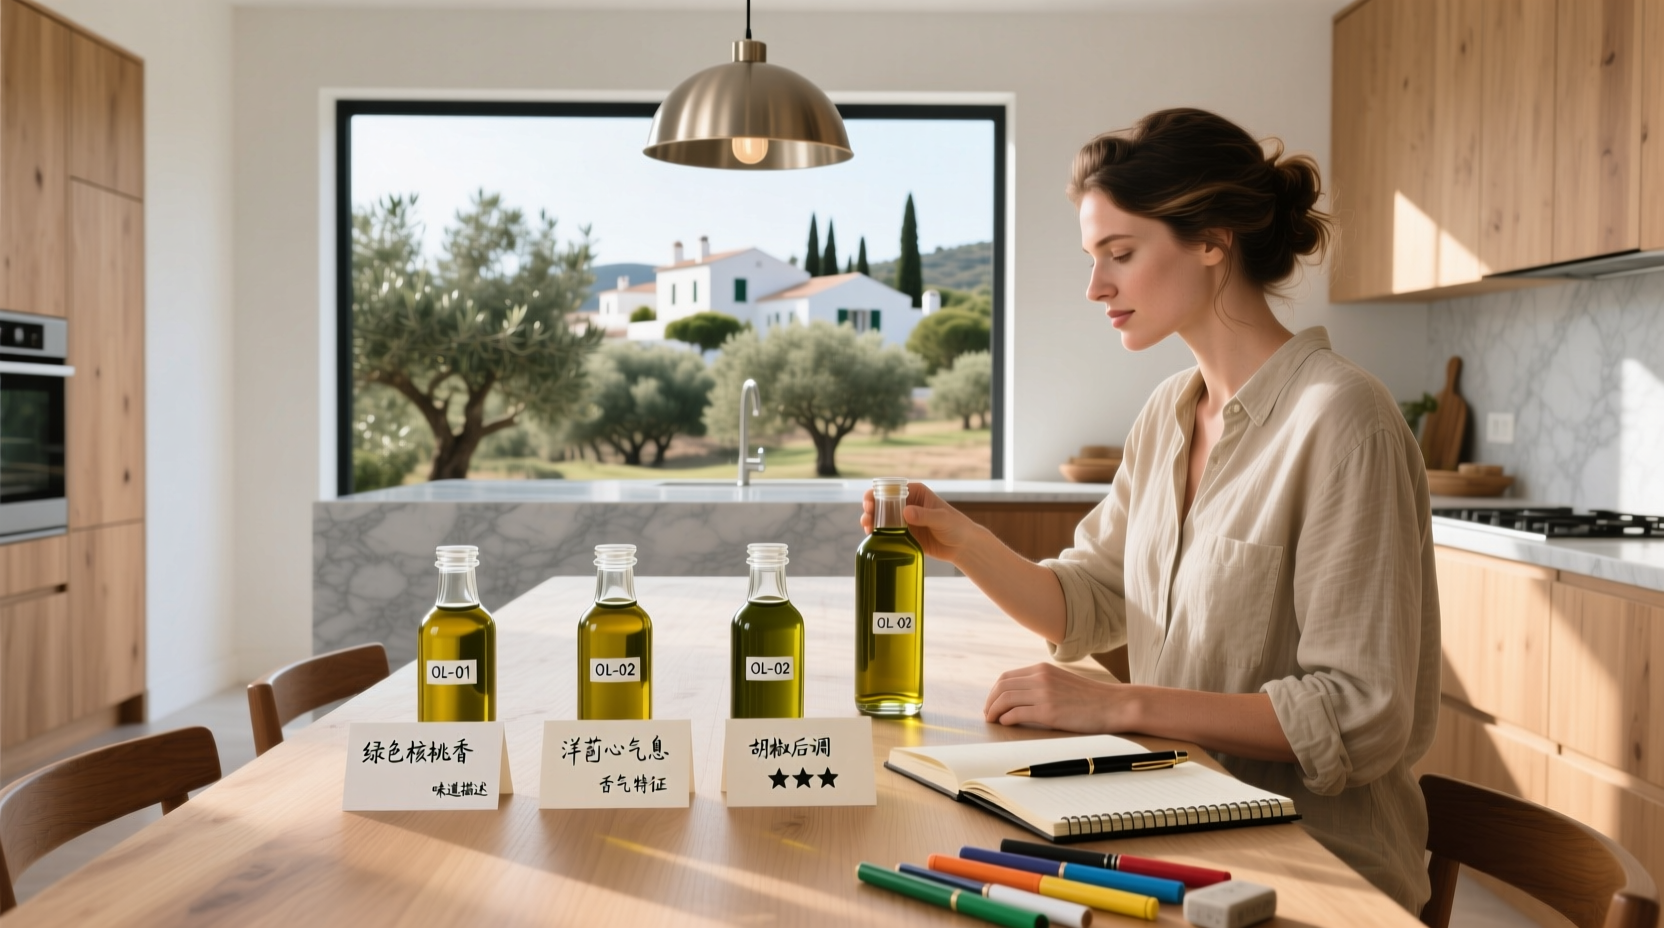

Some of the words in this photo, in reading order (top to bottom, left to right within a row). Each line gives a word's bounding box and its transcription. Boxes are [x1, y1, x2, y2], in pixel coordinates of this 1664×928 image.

[431, 664, 470, 679] OL-01
[595, 662, 636, 677] OL-02
[750, 661, 791, 676] OL-02
[362, 738, 474, 765] 绿色核桃香
[748, 736, 831, 760] 胡椒后调
